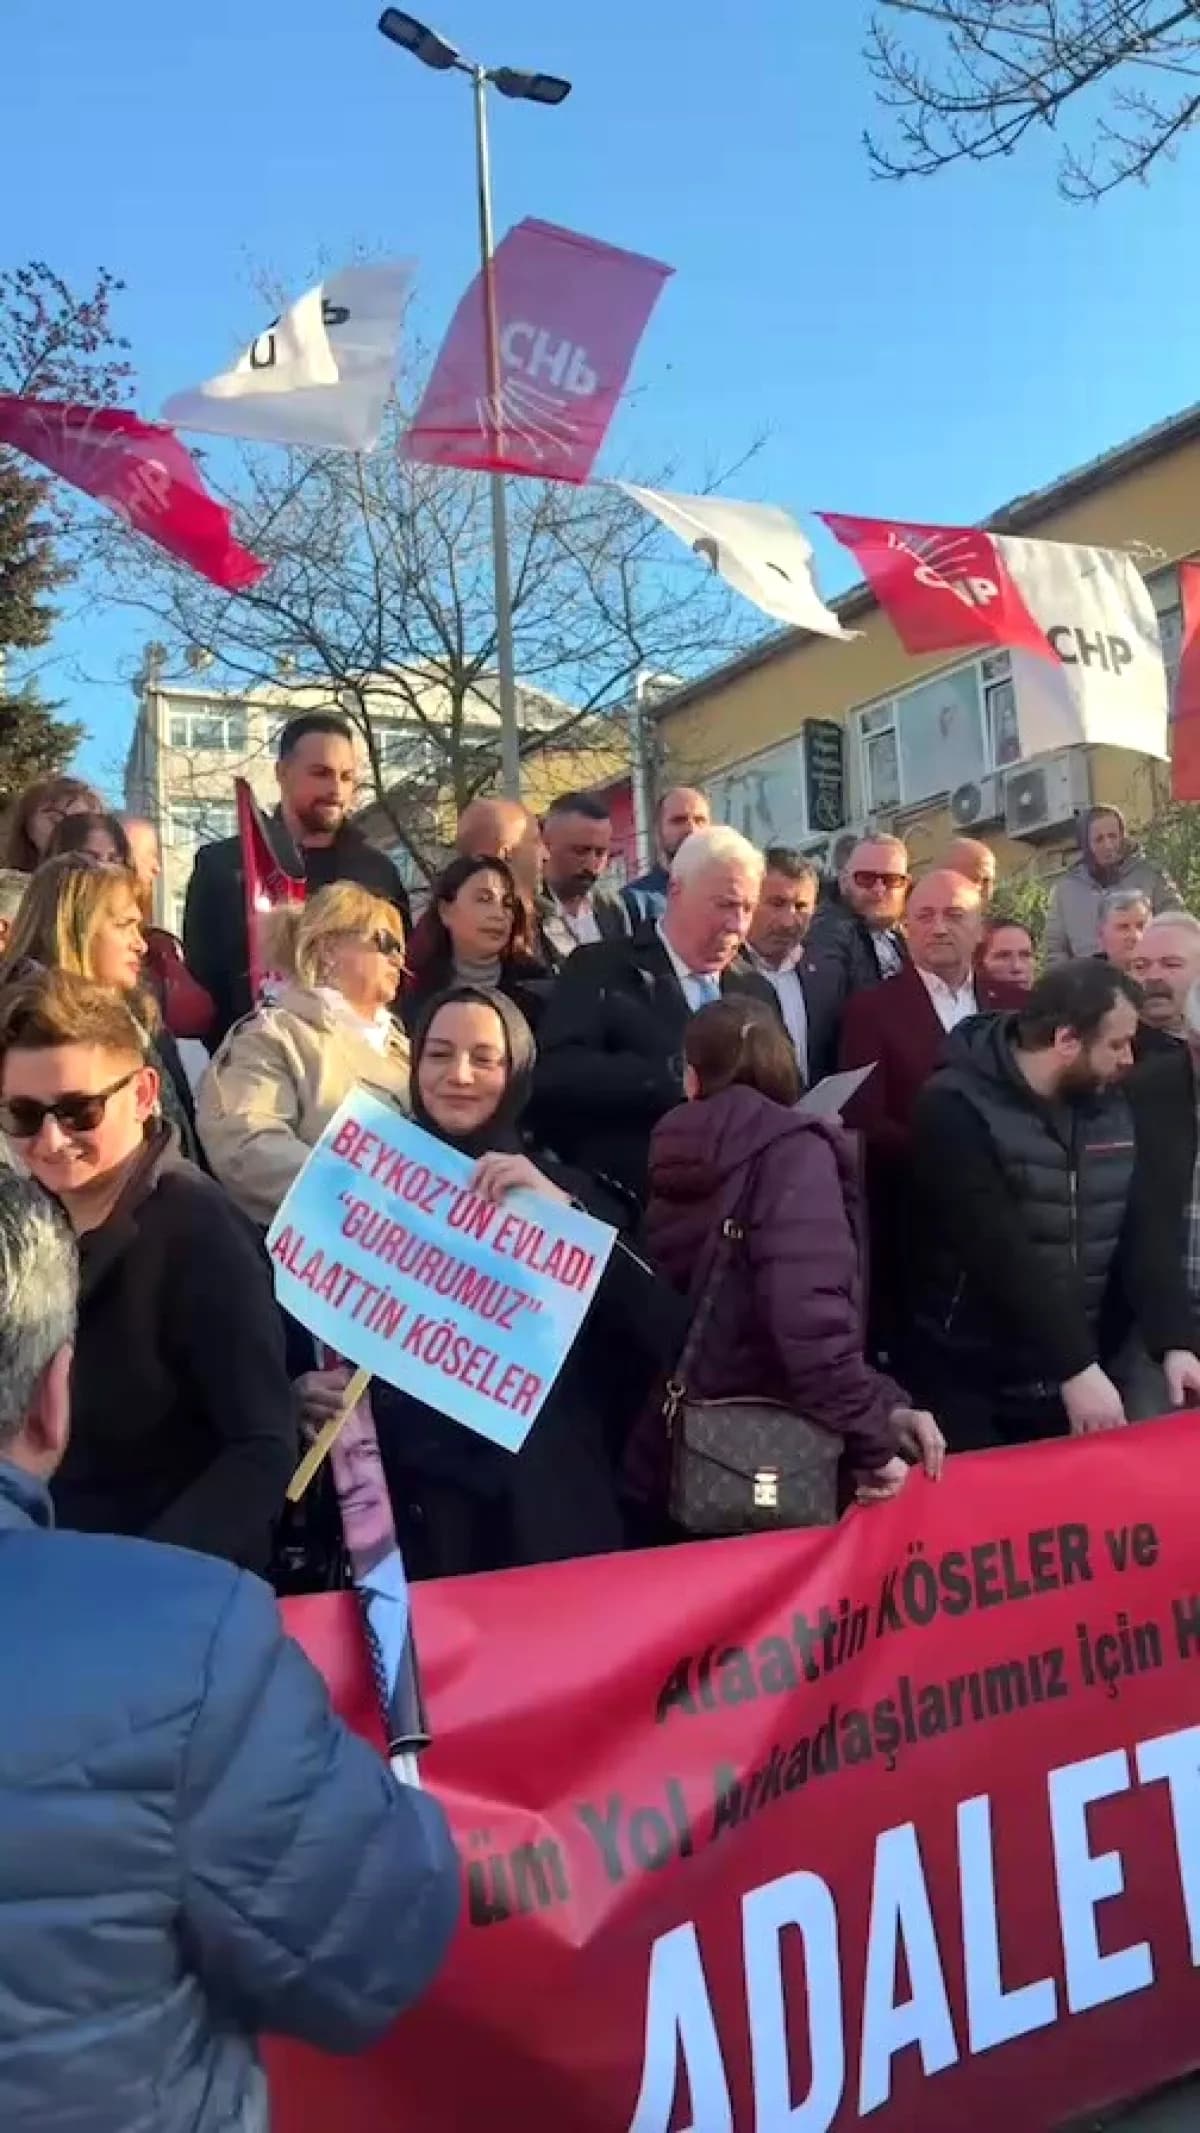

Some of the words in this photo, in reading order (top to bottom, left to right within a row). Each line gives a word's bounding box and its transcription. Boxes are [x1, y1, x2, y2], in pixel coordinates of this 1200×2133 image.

[1046, 625, 1134, 677] CHP
[271, 1224, 408, 1341] ALAATTİN
[401, 1313, 543, 1416] KÖSELER
[491, 1213, 597, 1292] EVLADI
[655, 1597, 868, 1725] Alaattin
[874, 1522, 1095, 1640] KÖSELER
[1104, 1522, 1160, 1573] ve
[467, 1829, 571, 1928] üm
[573, 1776, 694, 1887] Yol
[709, 1646, 1069, 1841] Arkadaşlarımız
[1077, 1610, 1163, 1699] için
[627, 1723, 1200, 2133] ADALET
